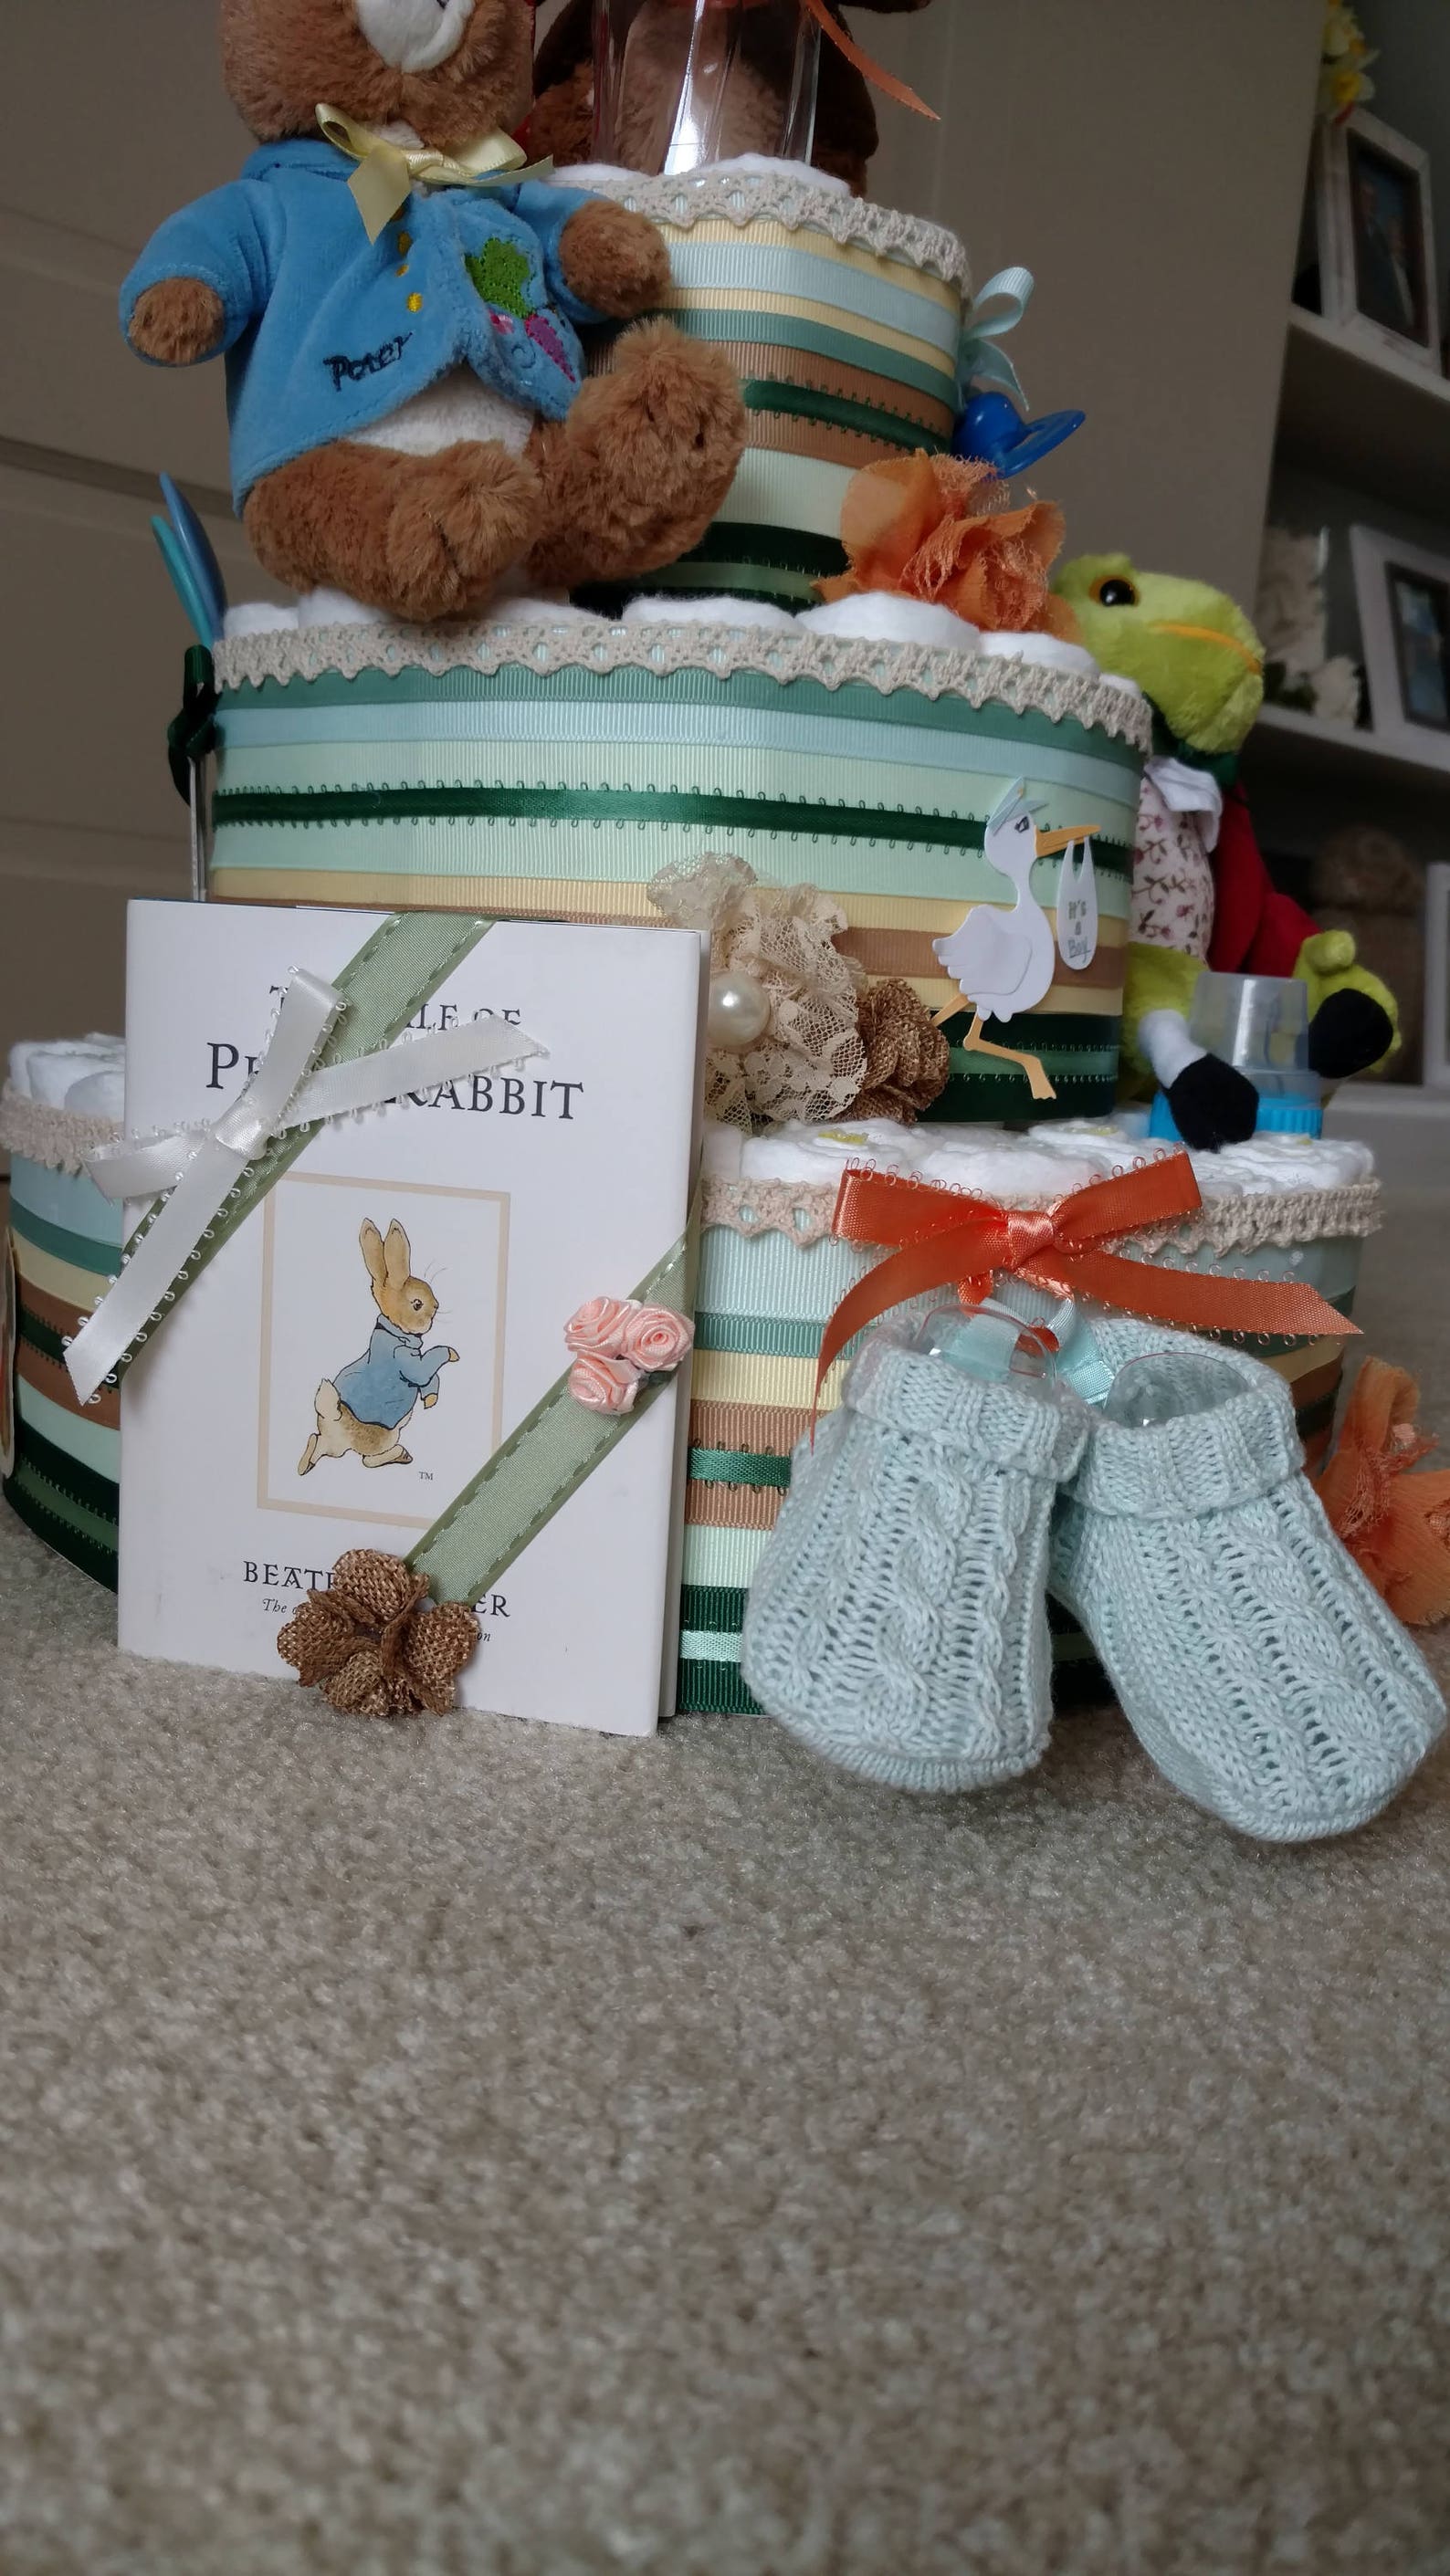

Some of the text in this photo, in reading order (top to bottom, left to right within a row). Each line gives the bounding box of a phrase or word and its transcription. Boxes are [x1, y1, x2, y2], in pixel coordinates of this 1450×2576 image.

[323, 332, 413, 392] Peter
[406, 1004, 458, 1031] LE
[384, 1072, 584, 1120] ABBIT
[242, 1560, 336, 1591] BEAT
[262, 1597, 288, 1614] The
